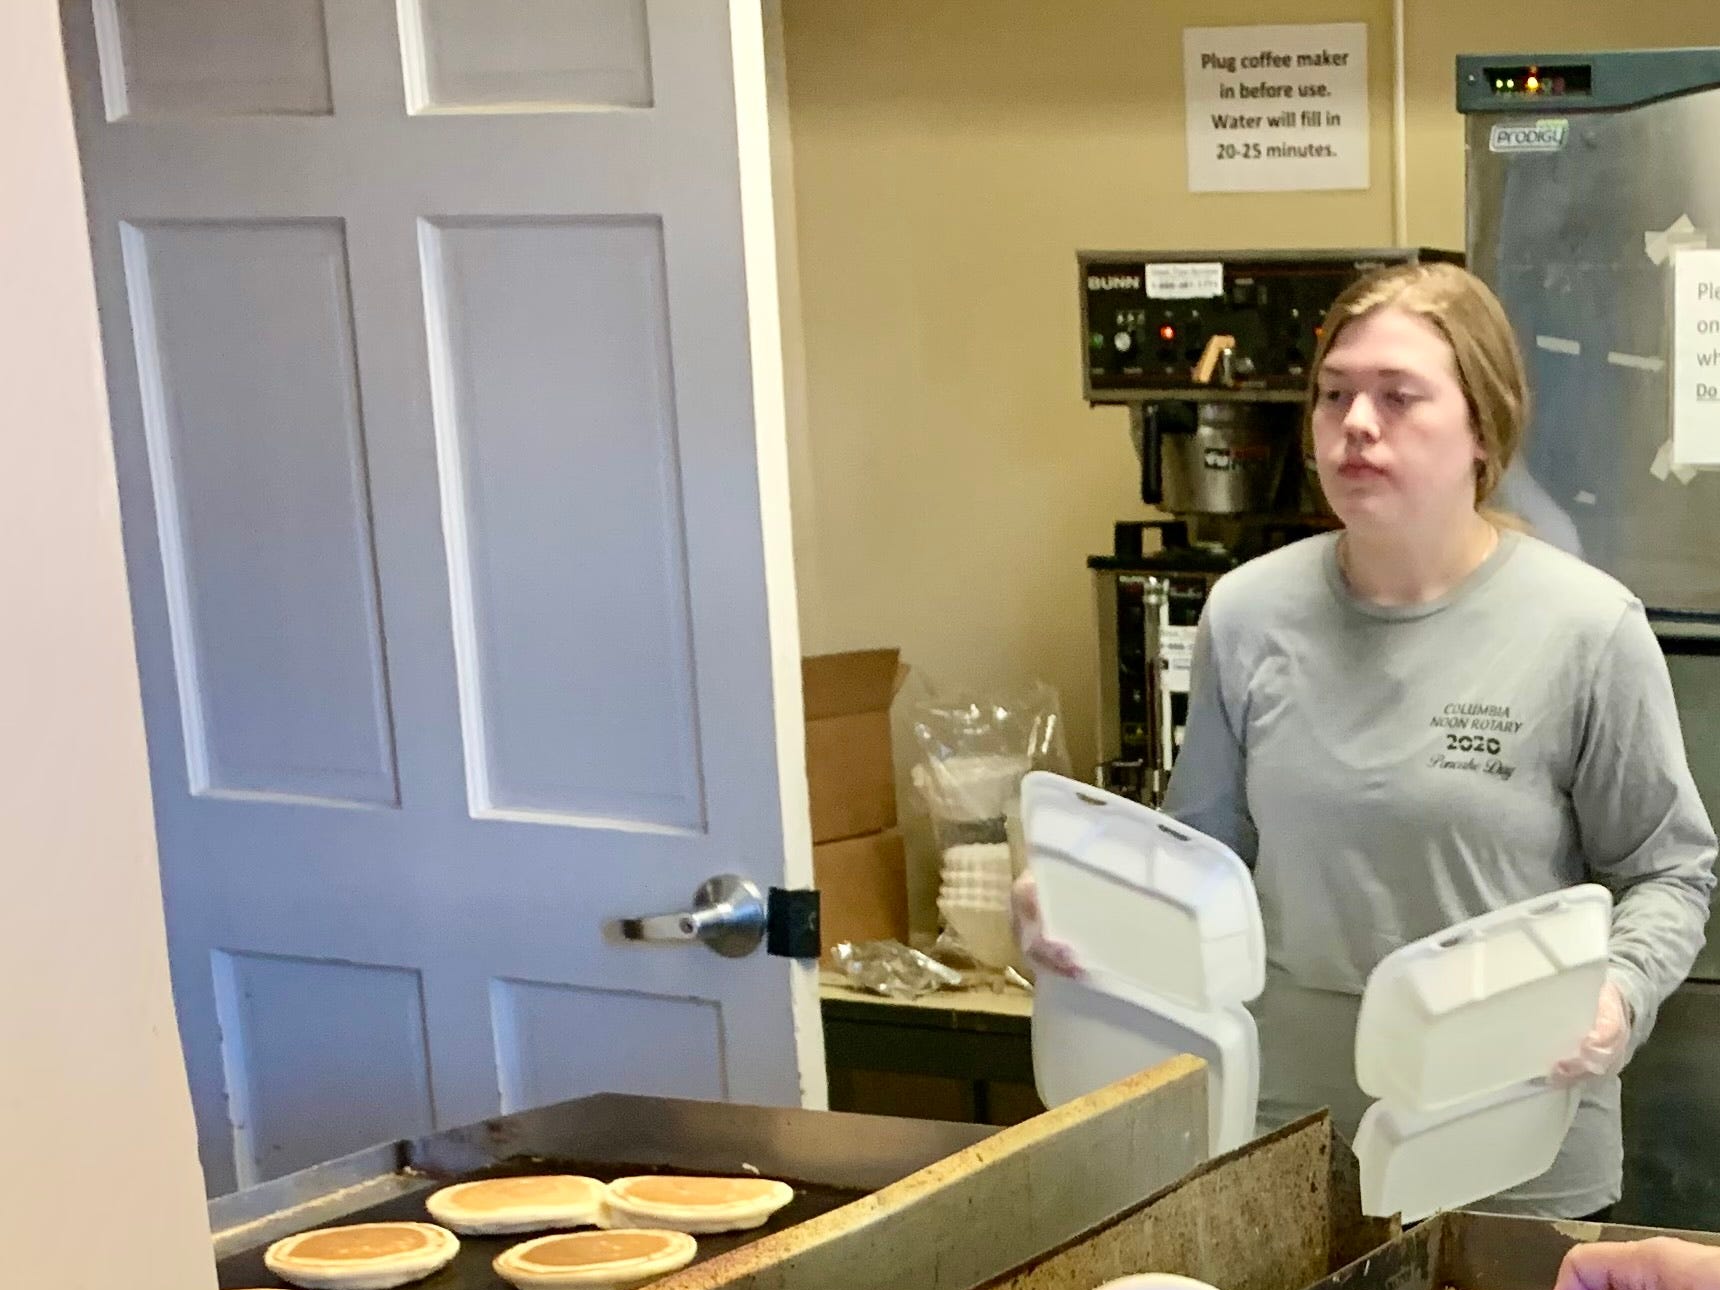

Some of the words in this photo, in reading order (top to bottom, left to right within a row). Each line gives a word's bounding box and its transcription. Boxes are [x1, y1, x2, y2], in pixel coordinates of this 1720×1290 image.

[1201, 53, 1236, 73] Plug
[1240, 51, 1292, 68] coffee
[1296, 50, 1349, 67] maker
[1219, 82, 1235, 99] in
[1239, 82, 1293, 99] before
[1298, 83, 1332, 98] use.
[1211, 113, 1262, 130] Water
[1267, 111, 1296, 128] will
[1301, 111, 1321, 128] fill
[1326, 110, 1341, 126] in
[1216, 143, 1262, 160] 20-25
[1266, 142, 1338, 158] minutes.
[1697, 318, 1720, 334] on
[1696, 383, 1717, 398] Do
[1443, 703, 1510, 718] COLUMBIA
[1430, 716, 1469, 729] NOON
[1471, 718, 1523, 733] ROTARY
[1446, 734, 1501, 755] 2020
